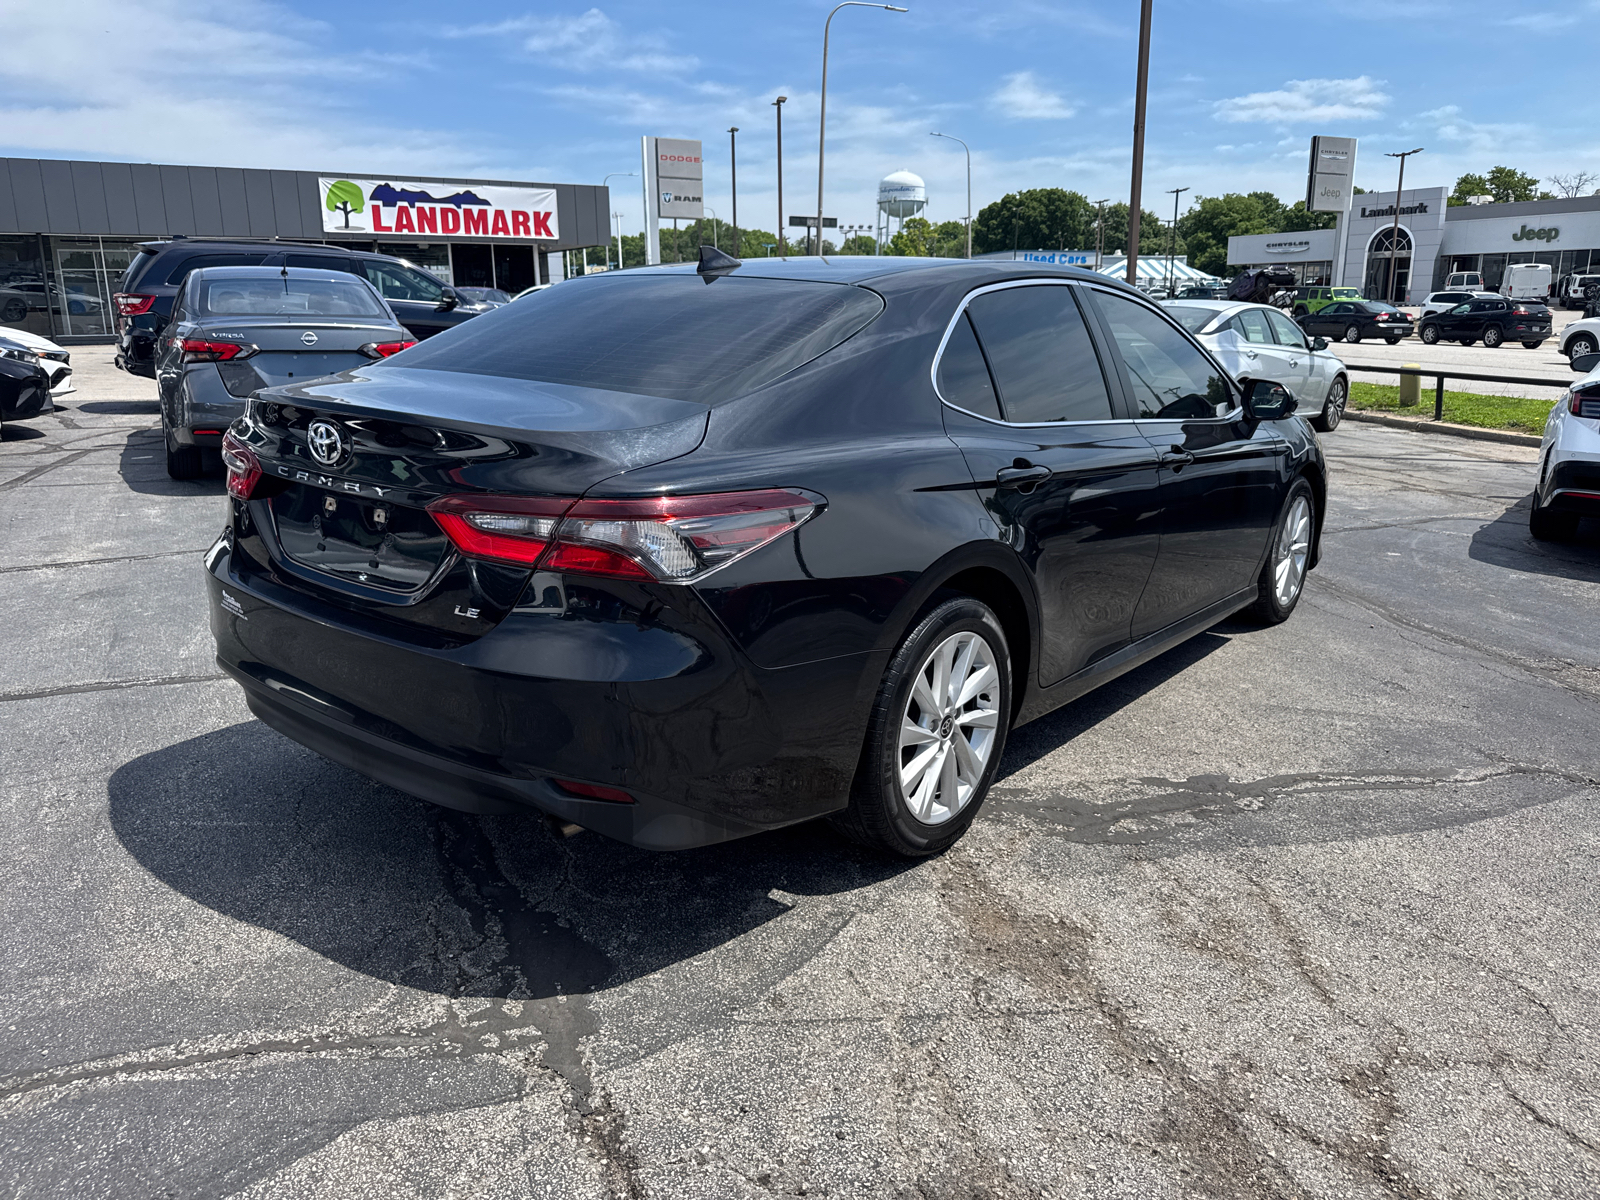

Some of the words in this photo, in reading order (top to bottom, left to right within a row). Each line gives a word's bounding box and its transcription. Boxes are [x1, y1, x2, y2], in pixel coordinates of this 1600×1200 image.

[660, 154, 701, 163] DODGE
[674, 195, 702, 203] RAM
[1321, 186, 1341, 199] Jeep
[1360, 202, 1428, 218] Landmark
[371, 204, 555, 238] LANDMARK
[1512, 224, 1560, 243] Jeep
[1024, 253, 1056, 264] Used
[1059, 253, 1087, 264] Cars
[277, 465, 392, 498] CAMRY
[454, 604, 481, 619] LE
